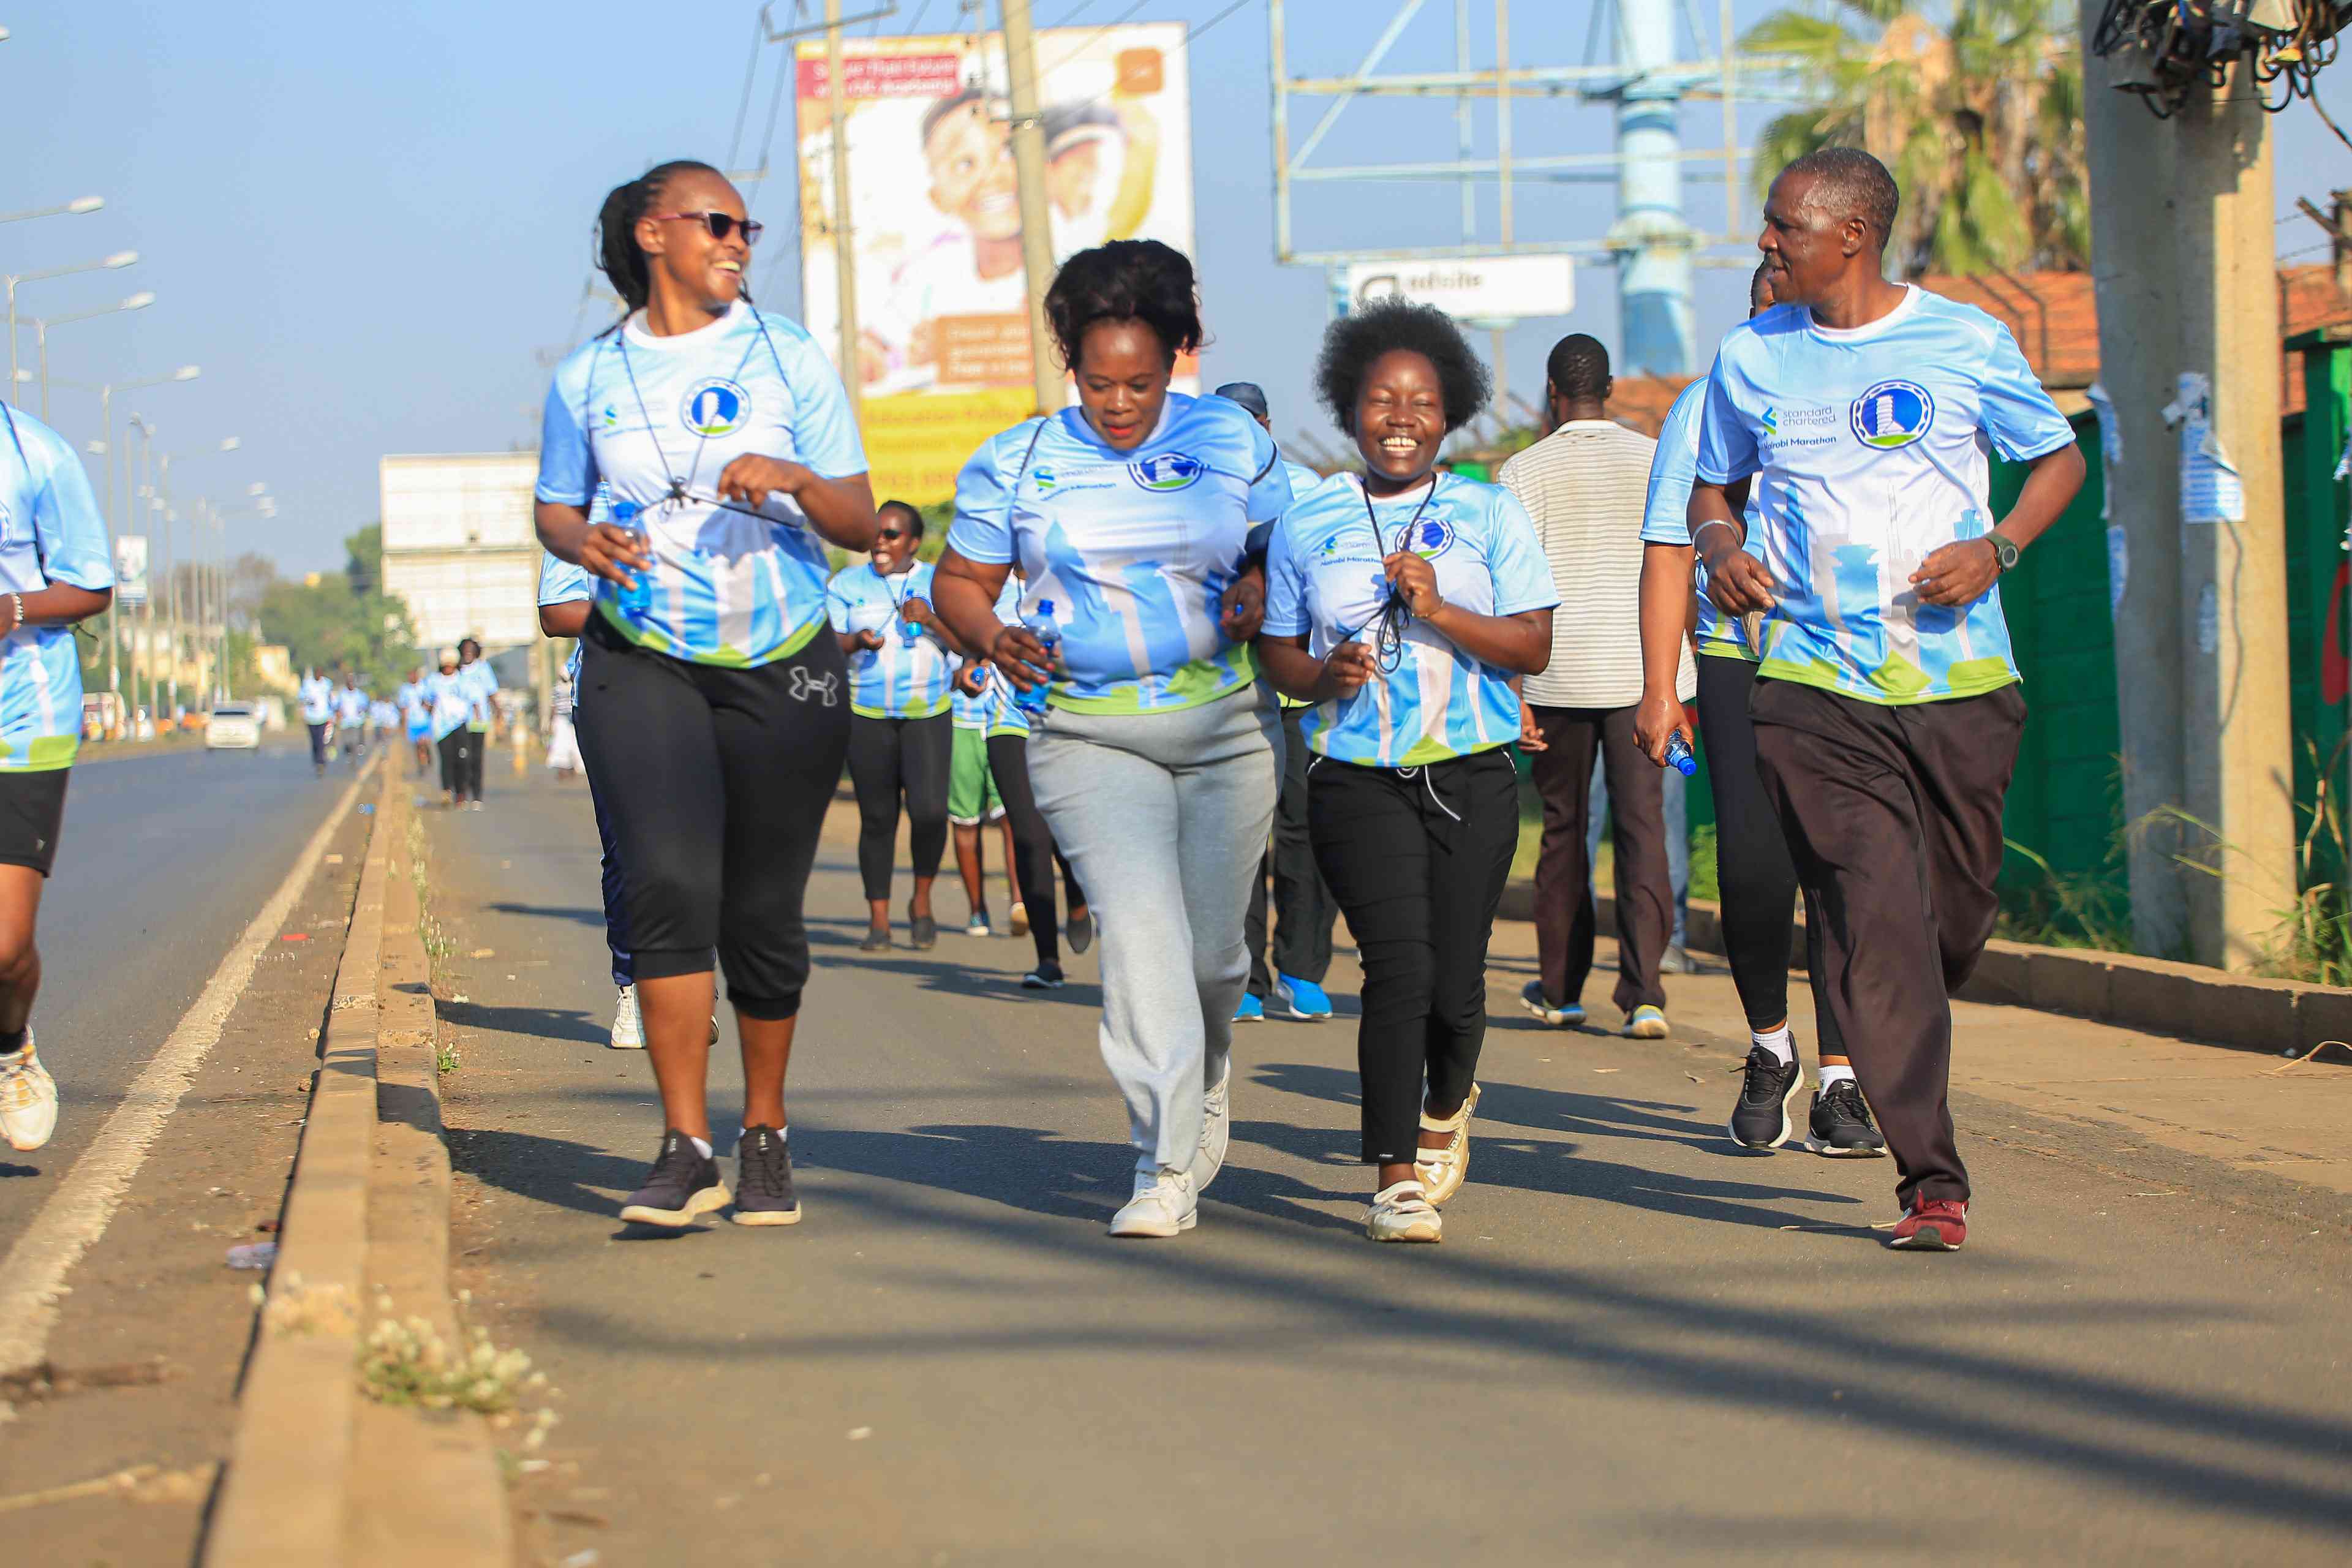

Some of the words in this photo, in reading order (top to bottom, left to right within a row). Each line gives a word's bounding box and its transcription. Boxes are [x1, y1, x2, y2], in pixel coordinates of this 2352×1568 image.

[1783, 405, 1832, 418] standard
[1783, 413, 1836, 426] chartered
[1764, 438, 1789, 450] Nairobi
[1790, 436, 1836, 446] Marathon
